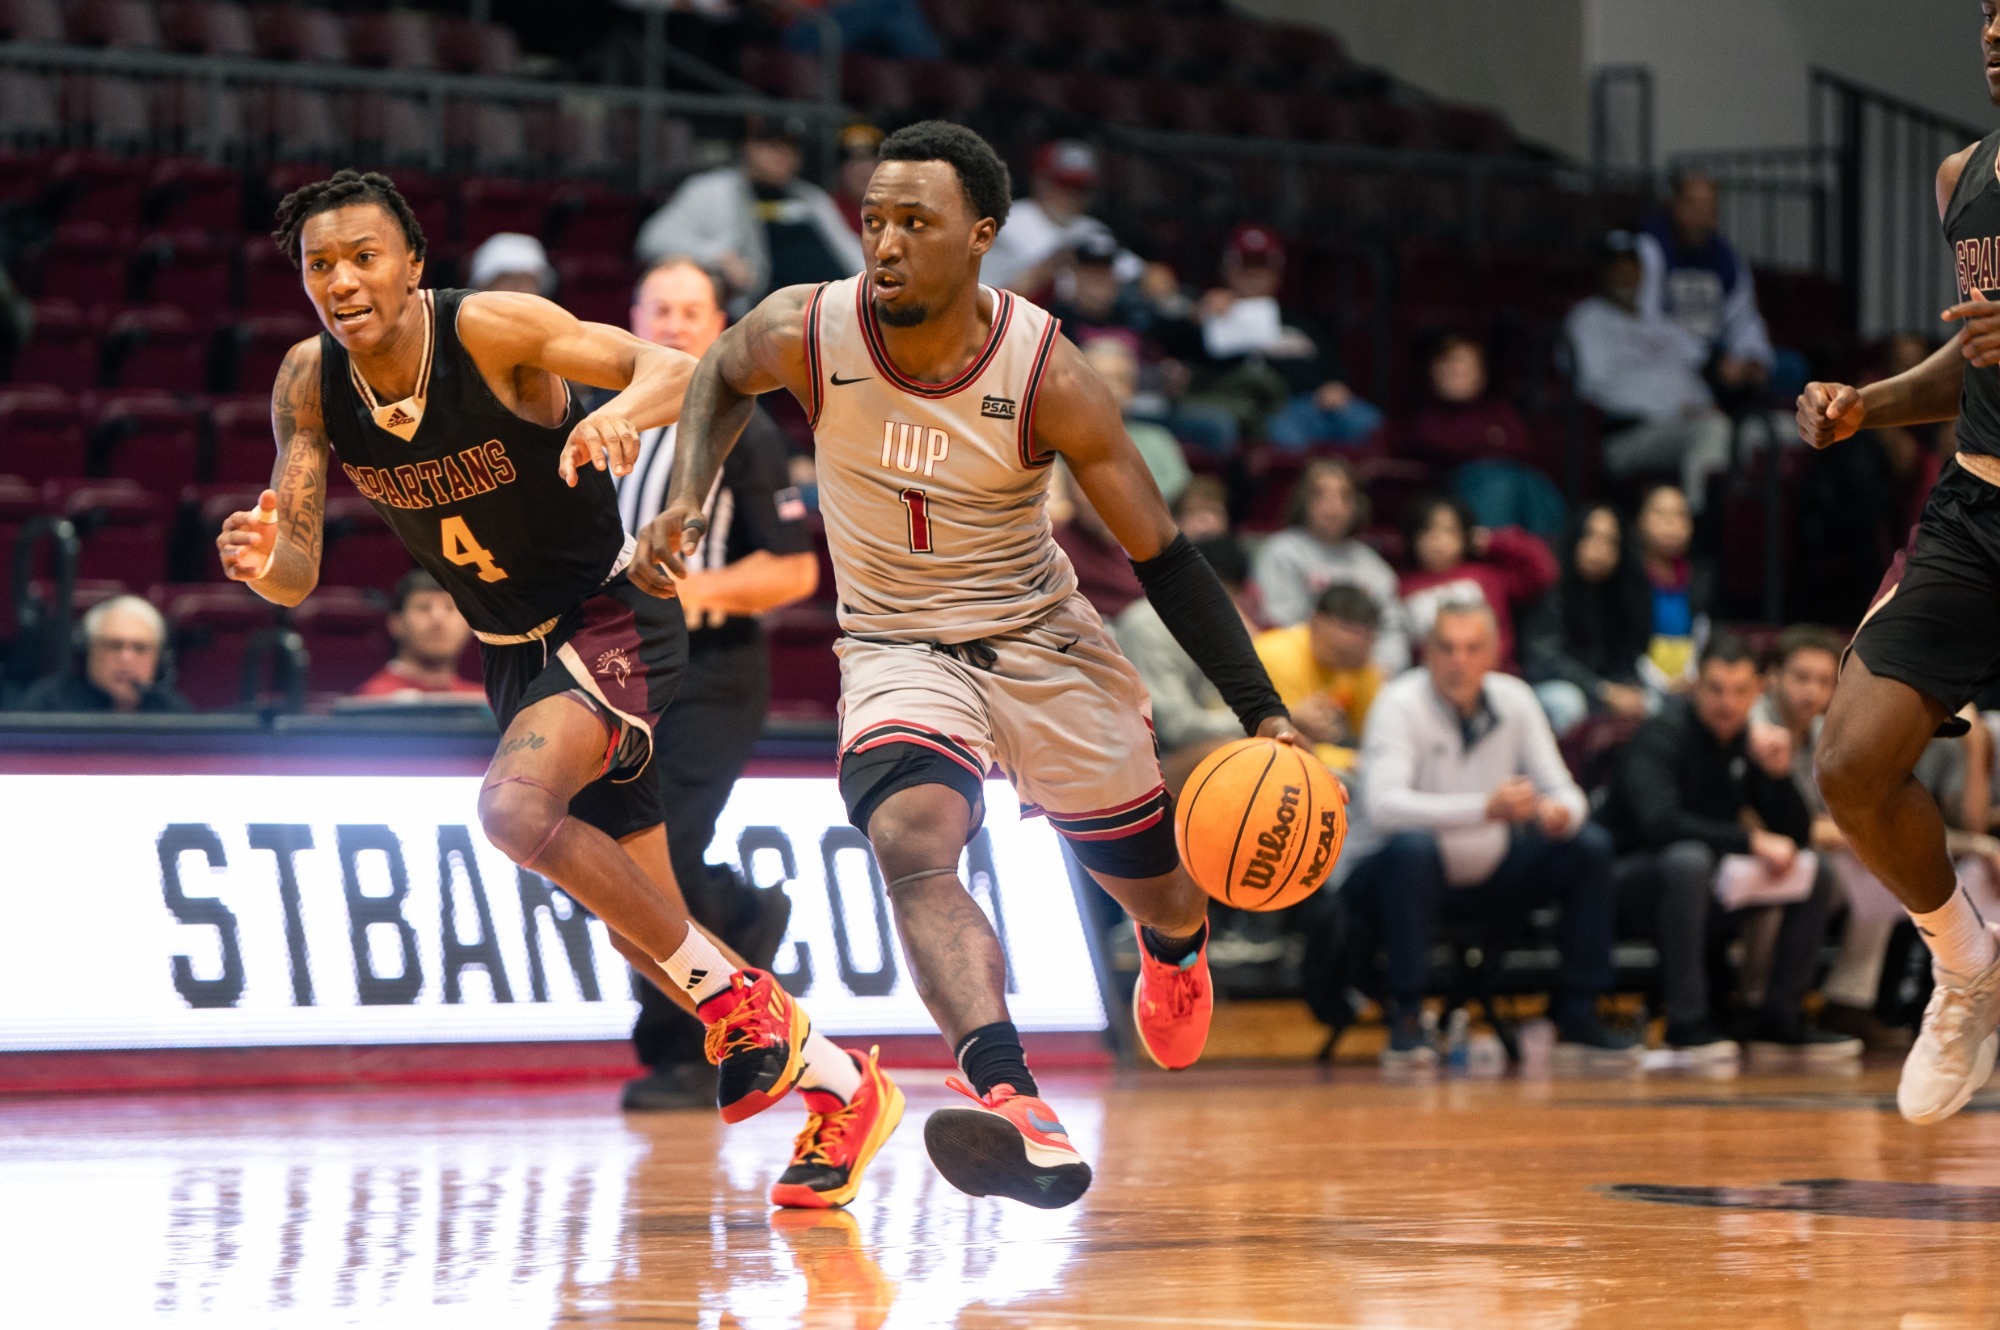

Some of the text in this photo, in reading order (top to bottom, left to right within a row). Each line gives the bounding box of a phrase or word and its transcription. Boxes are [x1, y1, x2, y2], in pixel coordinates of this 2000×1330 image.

[1955, 236, 2000, 295] SPA
[387, 416, 415, 428] adidas
[981, 401, 1016, 415] PSAC
[342, 439, 516, 509] SPARTANS
[880, 420, 950, 478] IUP
[441, 515, 508, 583] 4
[900, 488, 933, 554] 1
[1240, 785, 1301, 890] Wilson
[1299, 810, 1336, 888] NCAA
